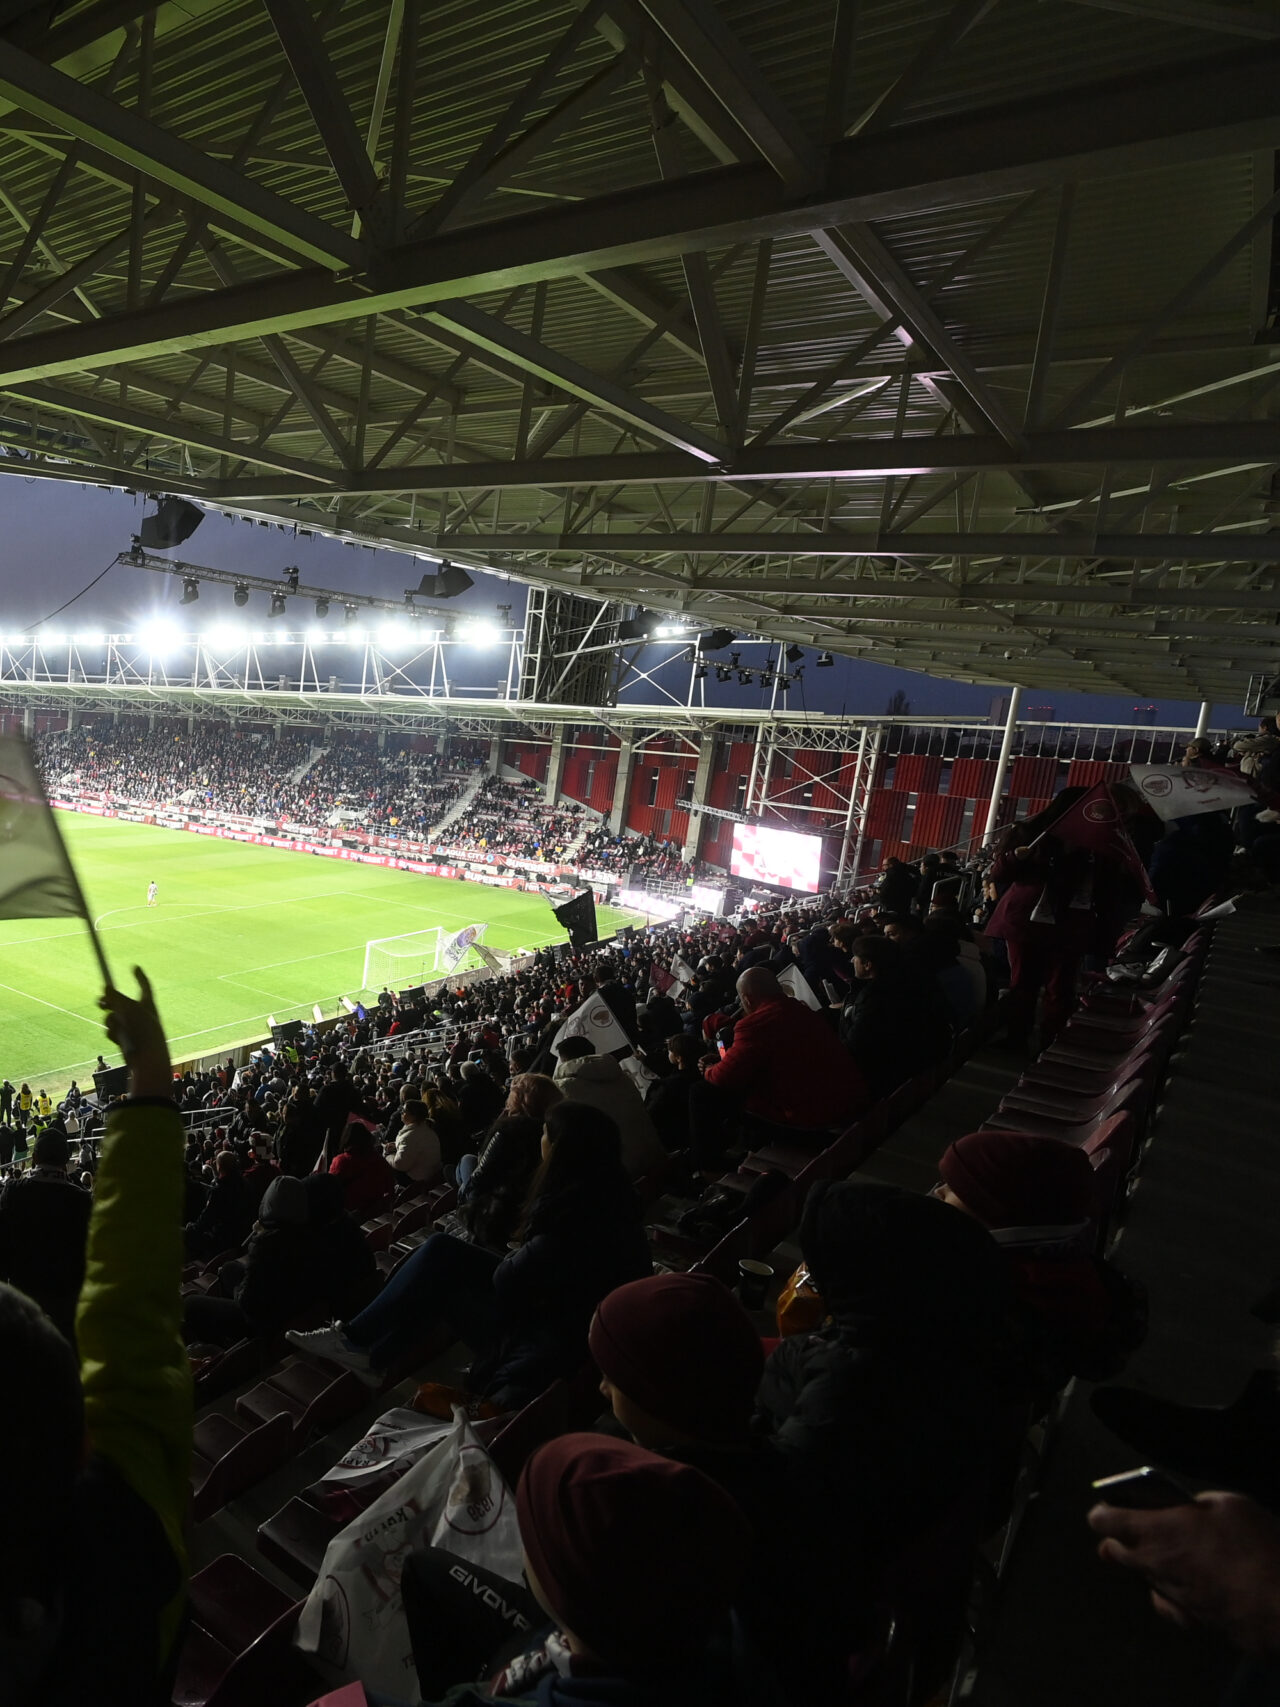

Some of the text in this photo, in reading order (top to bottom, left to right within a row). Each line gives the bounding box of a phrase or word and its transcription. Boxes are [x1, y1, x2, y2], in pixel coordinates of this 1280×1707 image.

[446, 849, 466, 857] AQUA
[468, 852, 486, 860] CITY
[464, 870, 513, 886] SUPERBET
